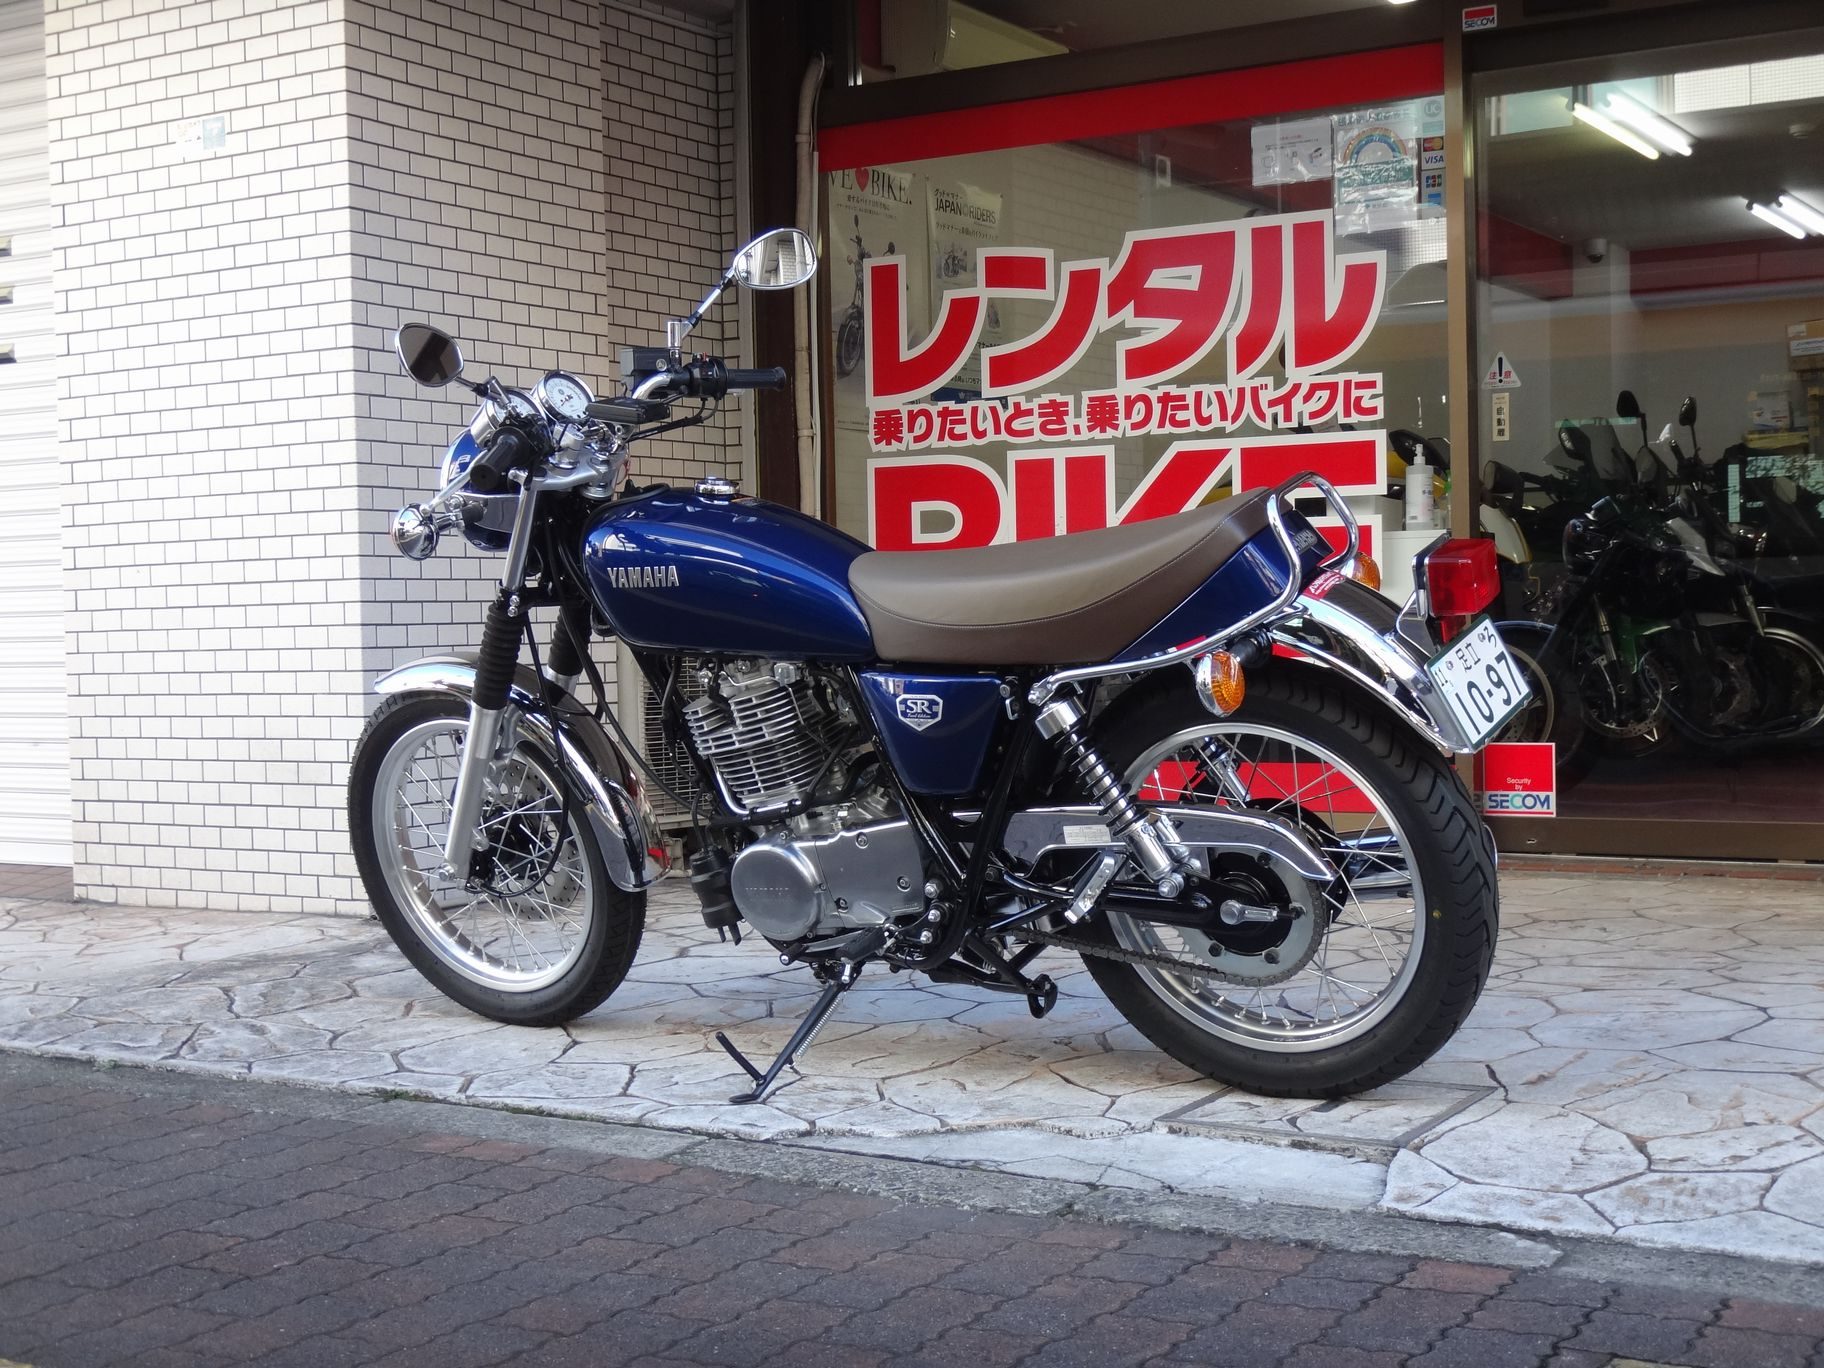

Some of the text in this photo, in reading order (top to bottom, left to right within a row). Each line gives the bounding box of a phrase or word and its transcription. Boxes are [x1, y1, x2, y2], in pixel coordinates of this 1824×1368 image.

[1464, 17, 1495, 28] SECOM
[1425, 156, 1444, 164] VISA
[935, 198, 997, 224] JAPAN RIDERS
[866, 213, 1386, 400] レンタル
[606, 565, 680, 588] YAMAHA
[1456, 642, 1481, 672] 足立
[1455, 650, 1522, 735] 10-97
[907, 699, 932, 713] SR
[1506, 777, 1532, 786] Security
[1488, 793, 1550, 810] SECOM
